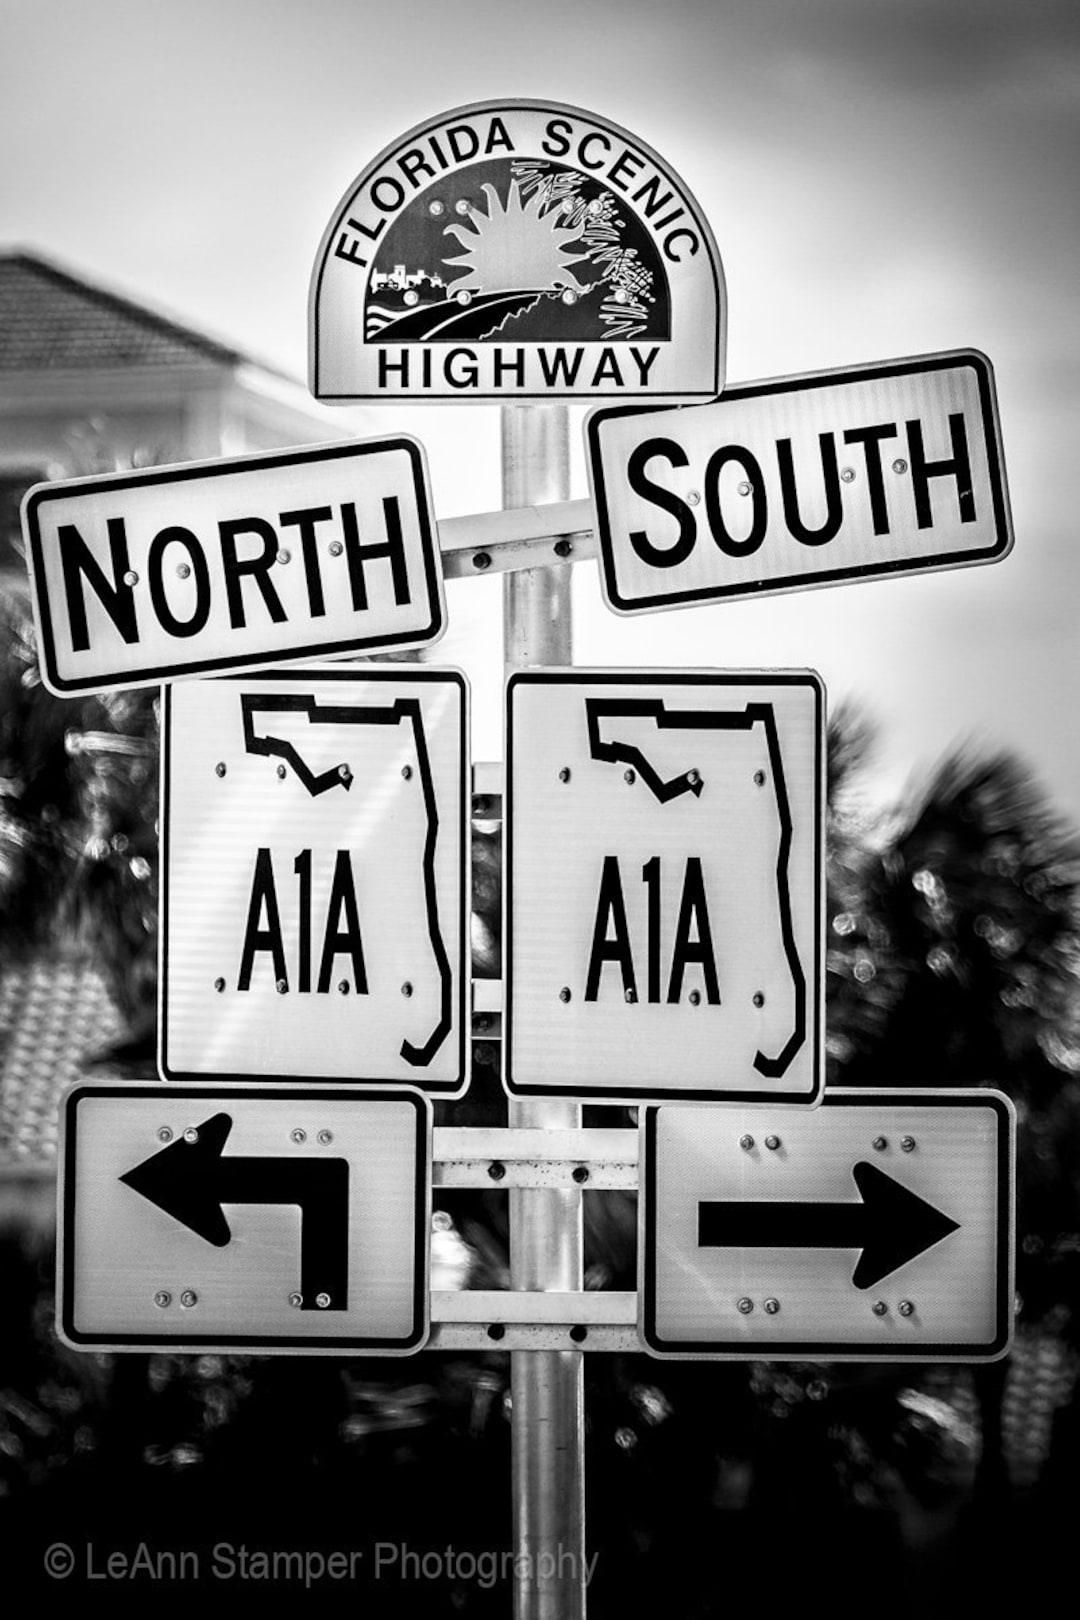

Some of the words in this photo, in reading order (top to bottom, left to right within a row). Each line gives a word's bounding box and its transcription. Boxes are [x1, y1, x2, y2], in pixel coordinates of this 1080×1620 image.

[334, 117, 515, 269] FLORIDA
[541, 119, 700, 264] SCENIC
[378, 347, 661, 389] HIGHWAY
[627, 412, 977, 570] SOUTH
[57, 495, 411, 653] NORTH
[237, 847, 370, 996] A1A
[583, 855, 723, 1007] A1A
